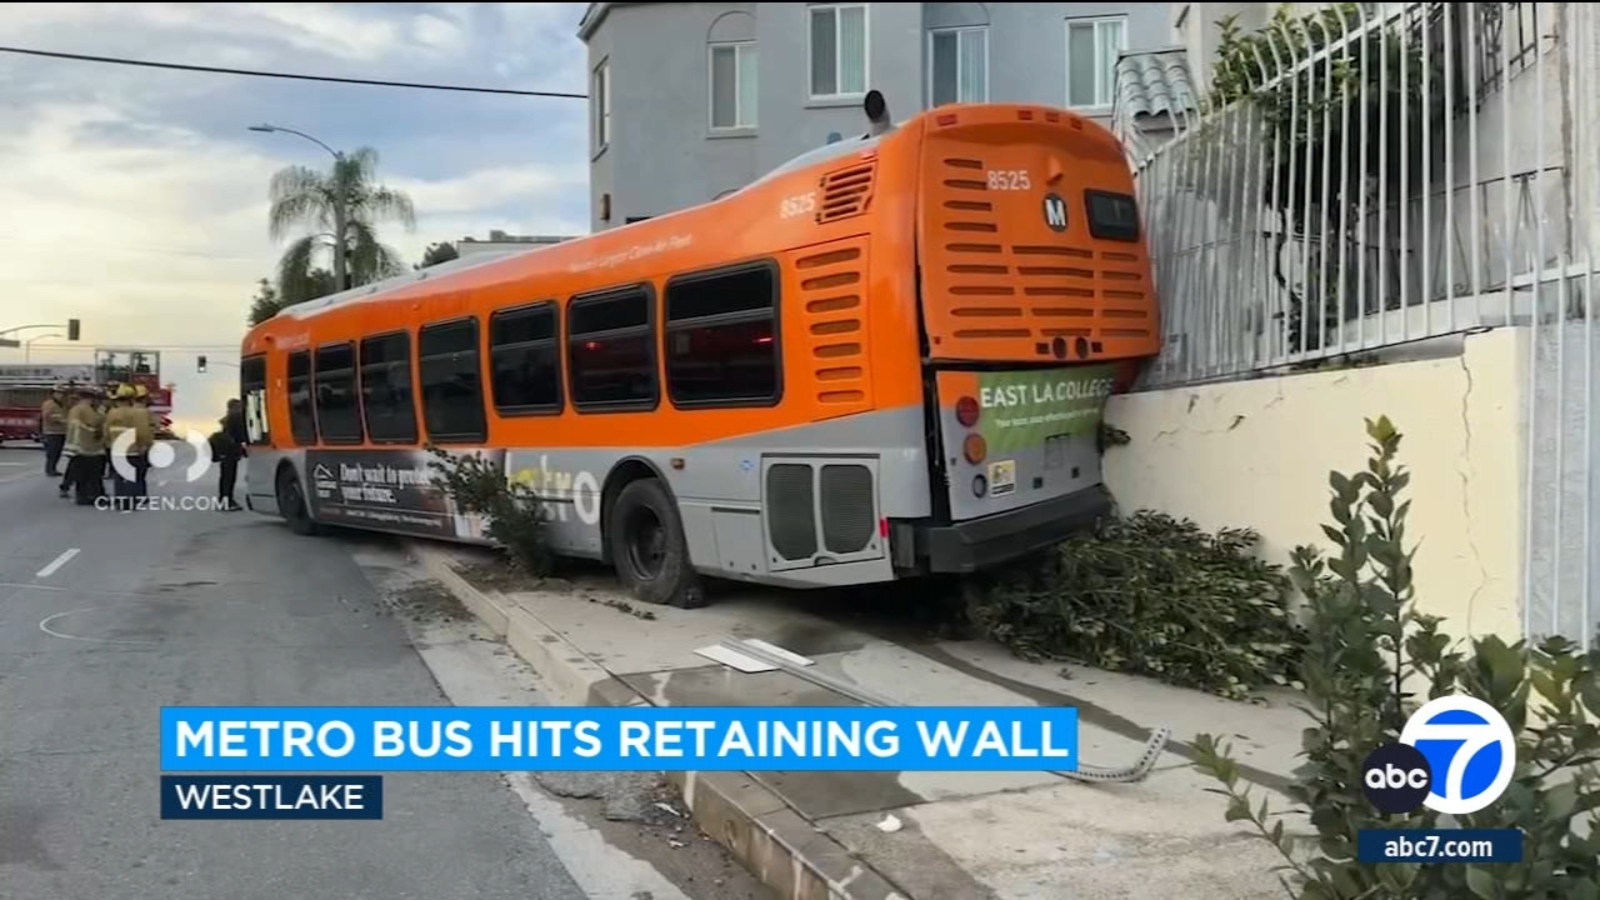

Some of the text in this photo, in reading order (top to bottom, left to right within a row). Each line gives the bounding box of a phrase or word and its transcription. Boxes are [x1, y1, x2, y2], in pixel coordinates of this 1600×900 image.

[988, 170, 1031, 191] 8525
[780, 192, 817, 219] 8525
[1045, 199, 1066, 226] M
[980, 384, 1027, 408] EAST
[1031, 381, 1055, 403] LA
[340, 462, 363, 482] Don't
[364, 463, 385, 483] wait
[386, 465, 398, 484] to
[341, 485, 362, 505] your
